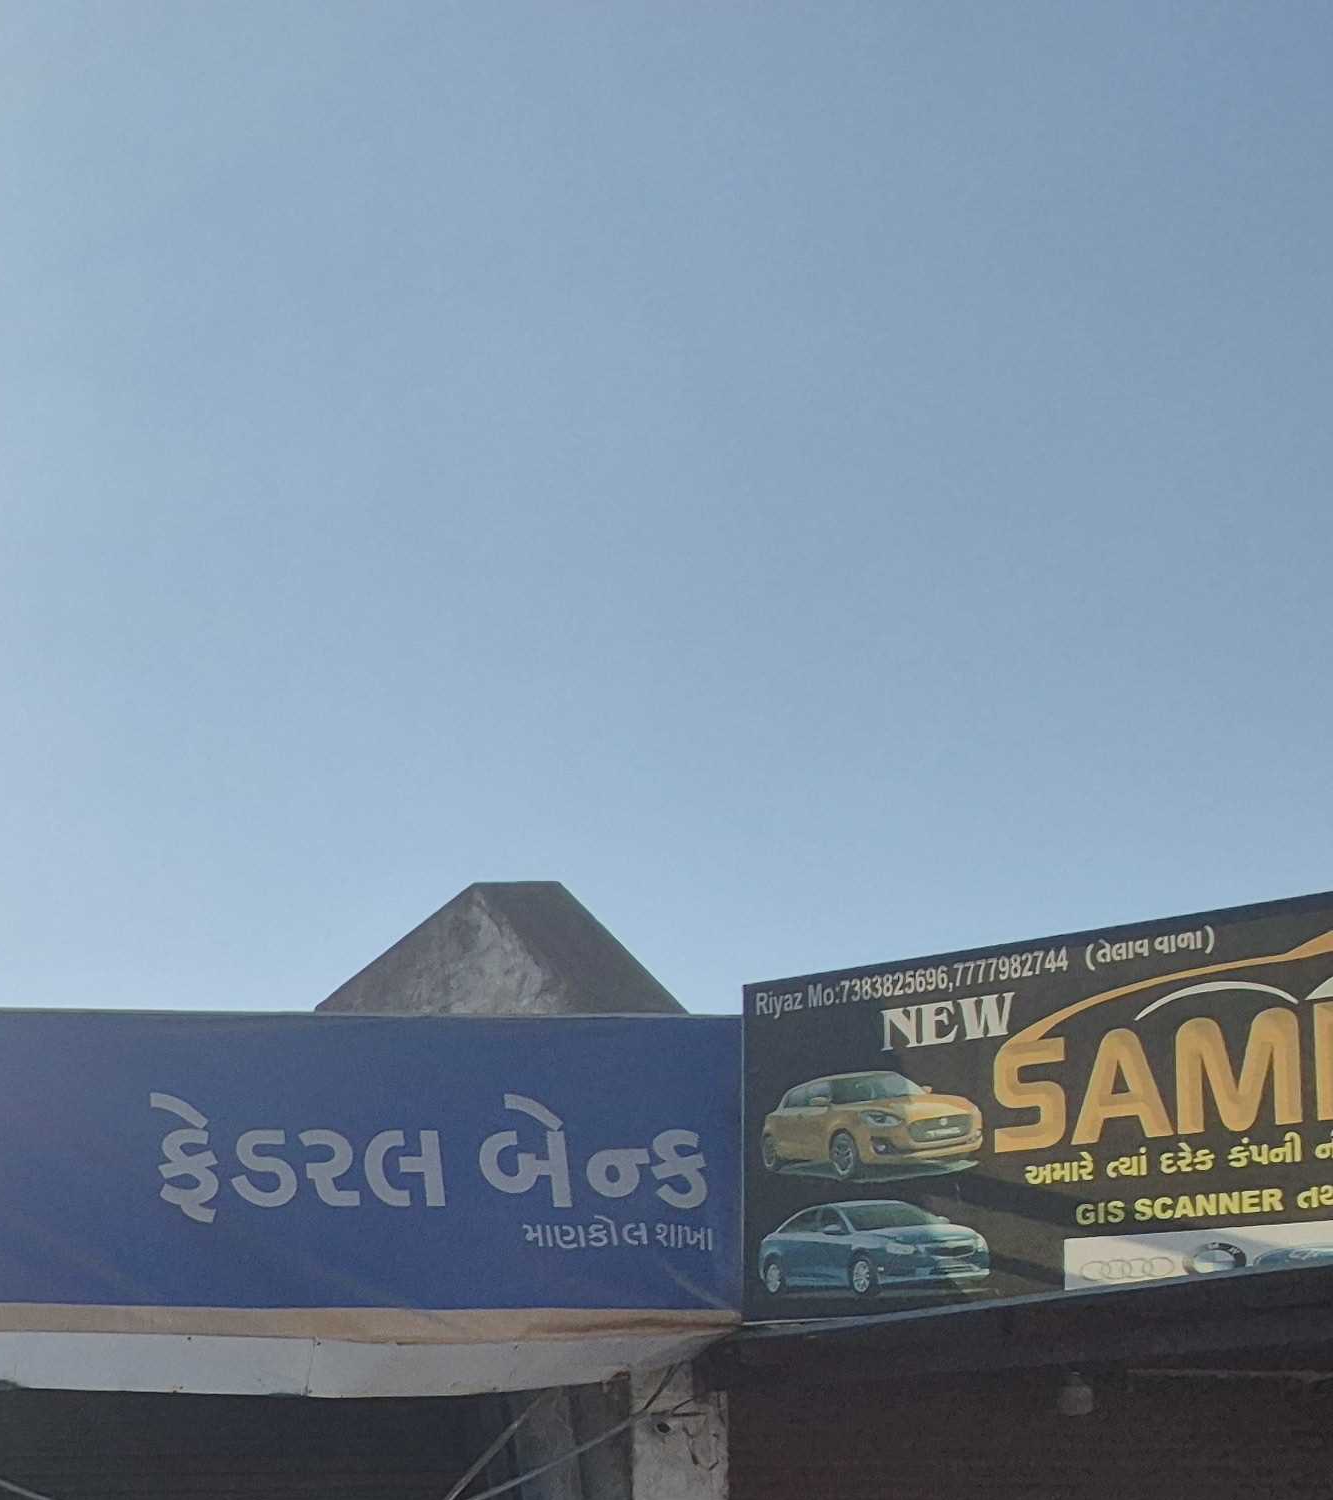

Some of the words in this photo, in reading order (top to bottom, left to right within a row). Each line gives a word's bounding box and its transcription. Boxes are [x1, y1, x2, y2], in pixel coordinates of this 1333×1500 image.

[756, 991, 803, 1019] Riyaz
[880, 991, 1015, 1052] NEW
[149, 1091, 446, 1223] ફેડરલ
[478, 1093, 709, 1209] બેન્ક
[1024, 1152, 1094, 1185] અમારે
[1106, 1146, 1148, 1178] ત્યાં
[1160, 1142, 1216, 1173] દરેક
[1227, 1131, 1303, 1168] કંપની
[1075, 1200, 1125, 1226] GIS
[1134, 1187, 1284, 1222] SCANNER
